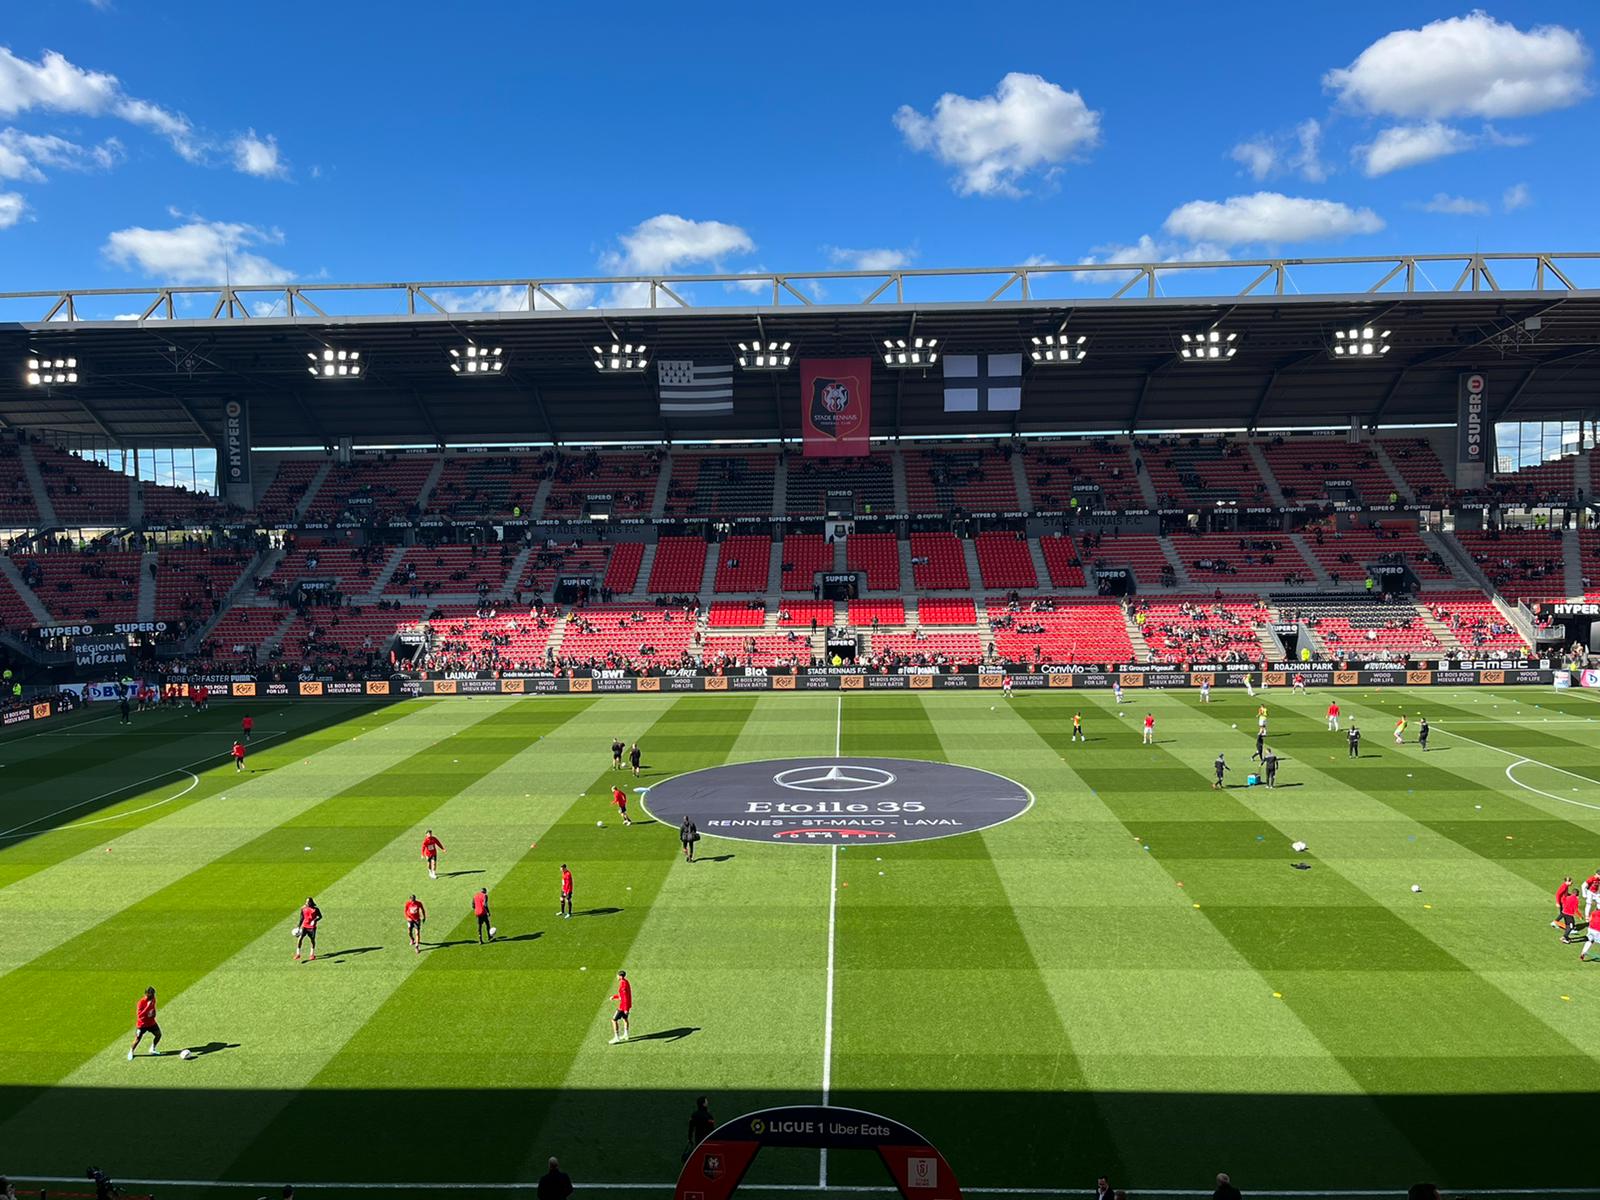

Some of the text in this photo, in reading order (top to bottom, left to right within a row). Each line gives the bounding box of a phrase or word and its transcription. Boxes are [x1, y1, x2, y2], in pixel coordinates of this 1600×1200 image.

[1468, 394, 1482, 443] SUPER
[229, 418, 241, 465] HYPER
[1554, 604, 1599, 614] HYPER
[40, 627, 80, 638] HYPER
[114, 623, 154, 633] SUPER
[1460, 661, 1528, 669] SAMSIC
[445, 672, 478, 680] LAUNAY
[602, 670, 625, 678] BWT
[745, 667, 767, 676] Blot
[744, 801, 926, 813] Etoile 35
[770, 1121, 890, 1136] LIGUE 1 Uber Eats
